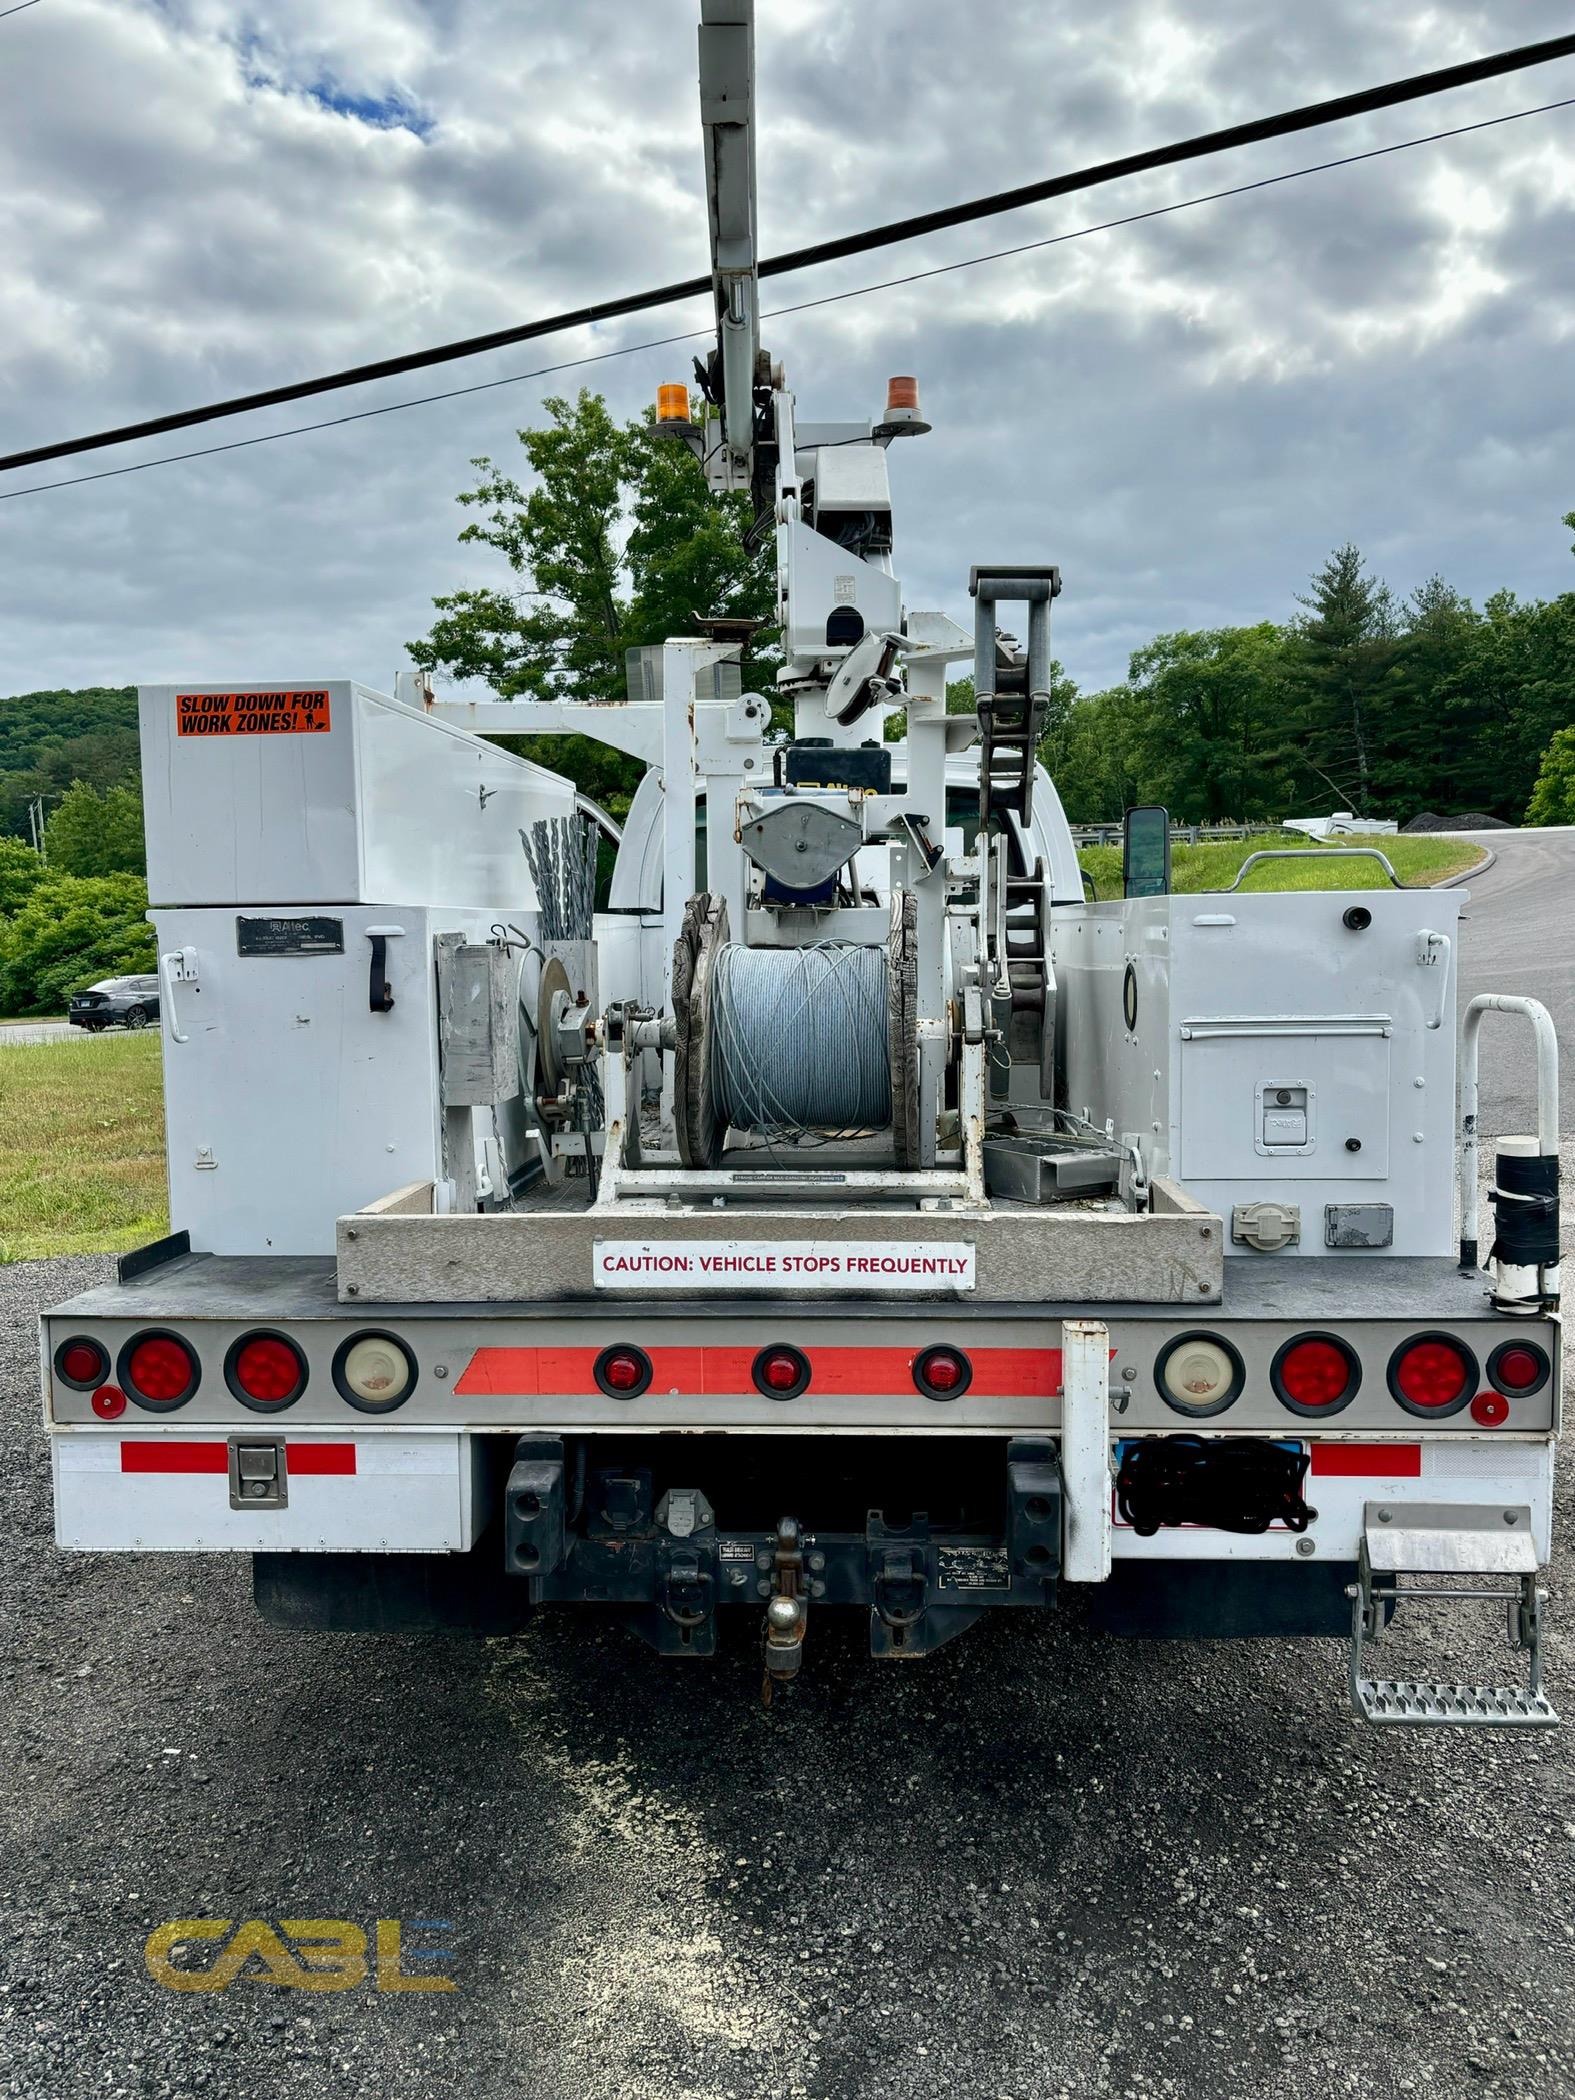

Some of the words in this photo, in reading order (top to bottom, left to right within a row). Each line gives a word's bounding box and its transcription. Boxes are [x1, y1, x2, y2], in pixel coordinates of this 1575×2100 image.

[180, 695, 230, 713] SLOW
[234, 694, 286, 712] DOWN
[291, 693, 325, 710] FOR
[181, 713, 232, 733] WORK
[236, 712, 298, 732] ZONES!
[602, 1256, 694, 1271] CAUTION:
[699, 1256, 777, 1271] VEHICLE
[782, 1256, 841, 1272] STOPS
[846, 1257, 968, 1273] FREQUENTLY
